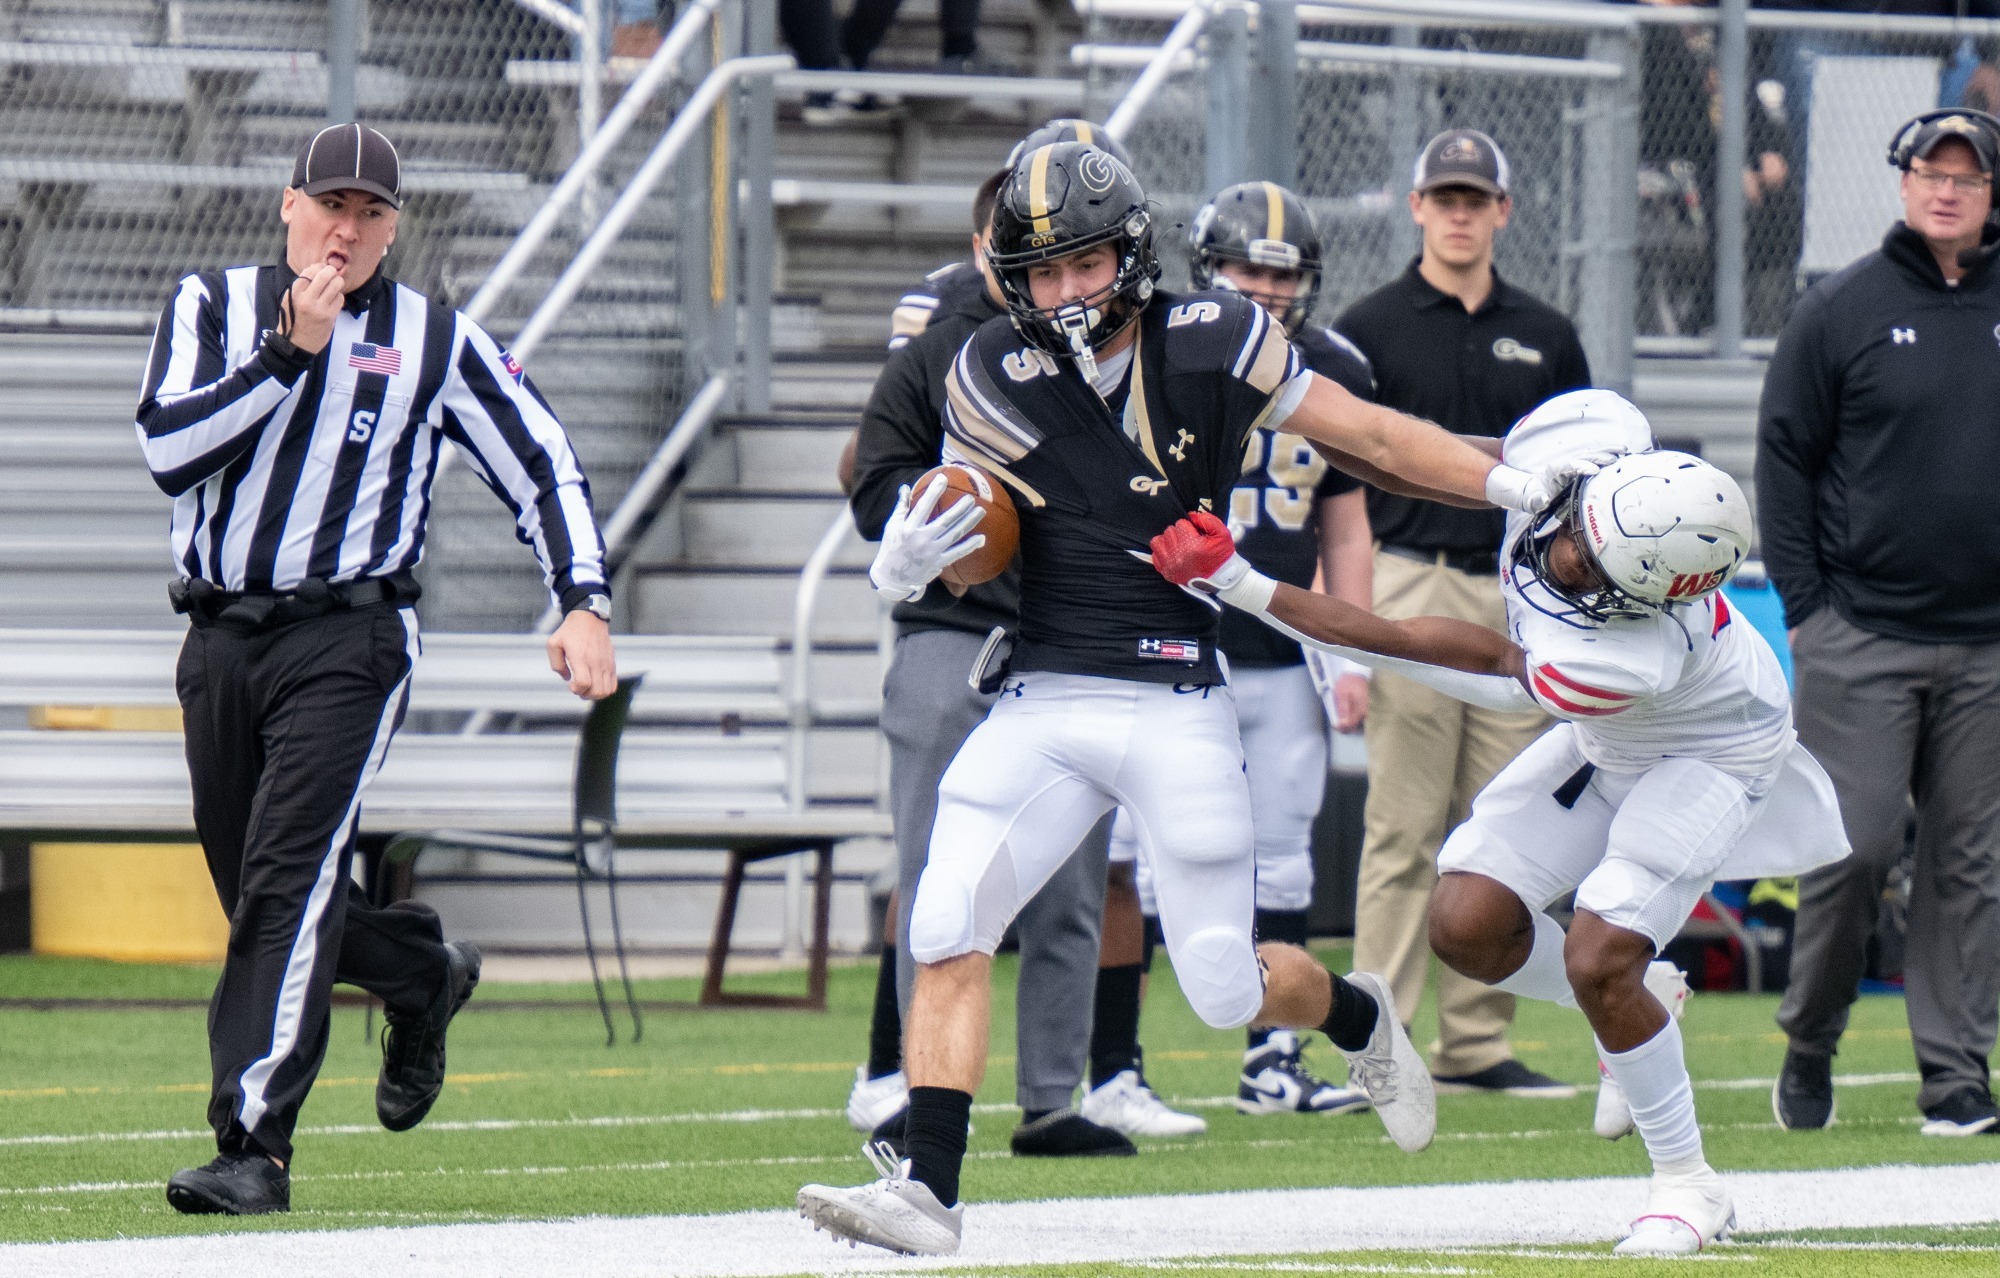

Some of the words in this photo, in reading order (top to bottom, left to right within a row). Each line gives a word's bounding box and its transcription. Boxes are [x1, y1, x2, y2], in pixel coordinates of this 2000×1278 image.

[1167, 302, 1221, 329] 5
[1002, 347, 1060, 382] 5
[349, 410, 376, 442] S
[1130, 476, 1169, 496] GT
